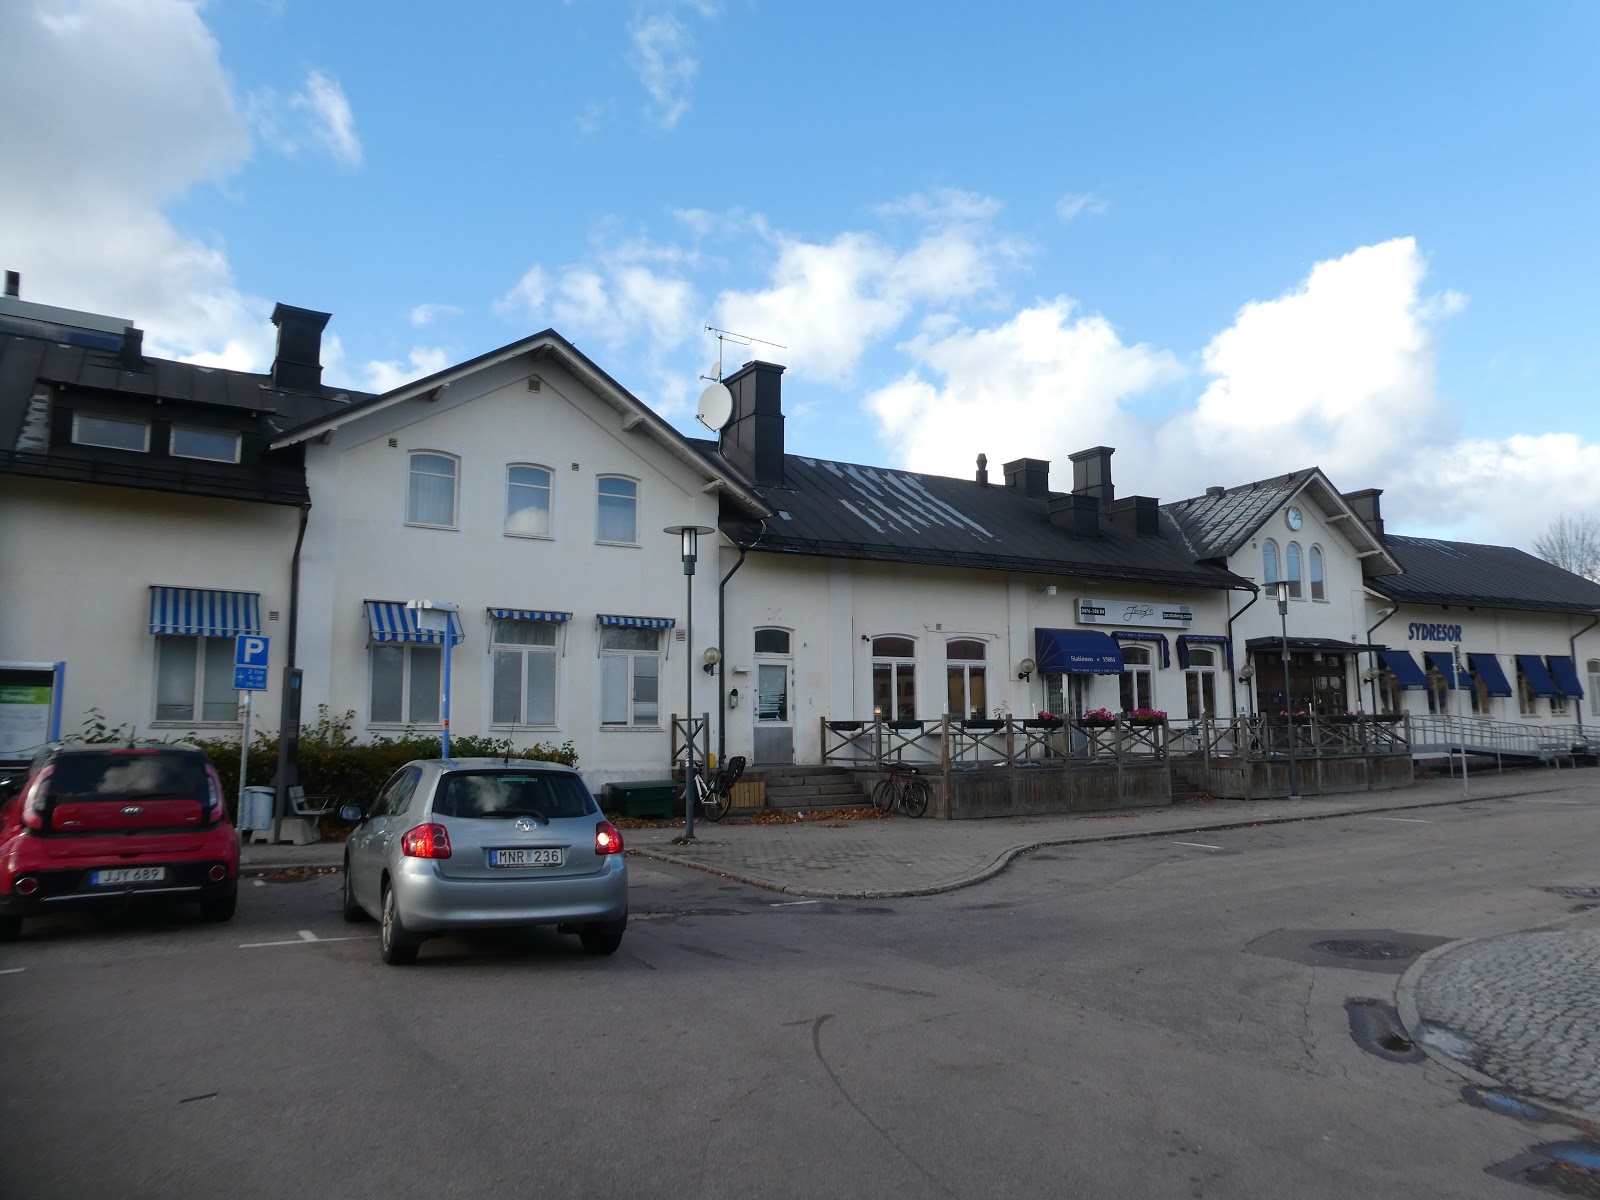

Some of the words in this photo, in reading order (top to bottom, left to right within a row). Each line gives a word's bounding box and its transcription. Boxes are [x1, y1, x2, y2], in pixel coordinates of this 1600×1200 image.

[1408, 622, 1462, 642] SYDRESOR
[244, 638, 264, 663] P
[499, 851, 525, 863] MNR
[534, 850, 559, 862] 236
[104, 870, 130, 882] JJY
[133, 868, 160, 880] 689
